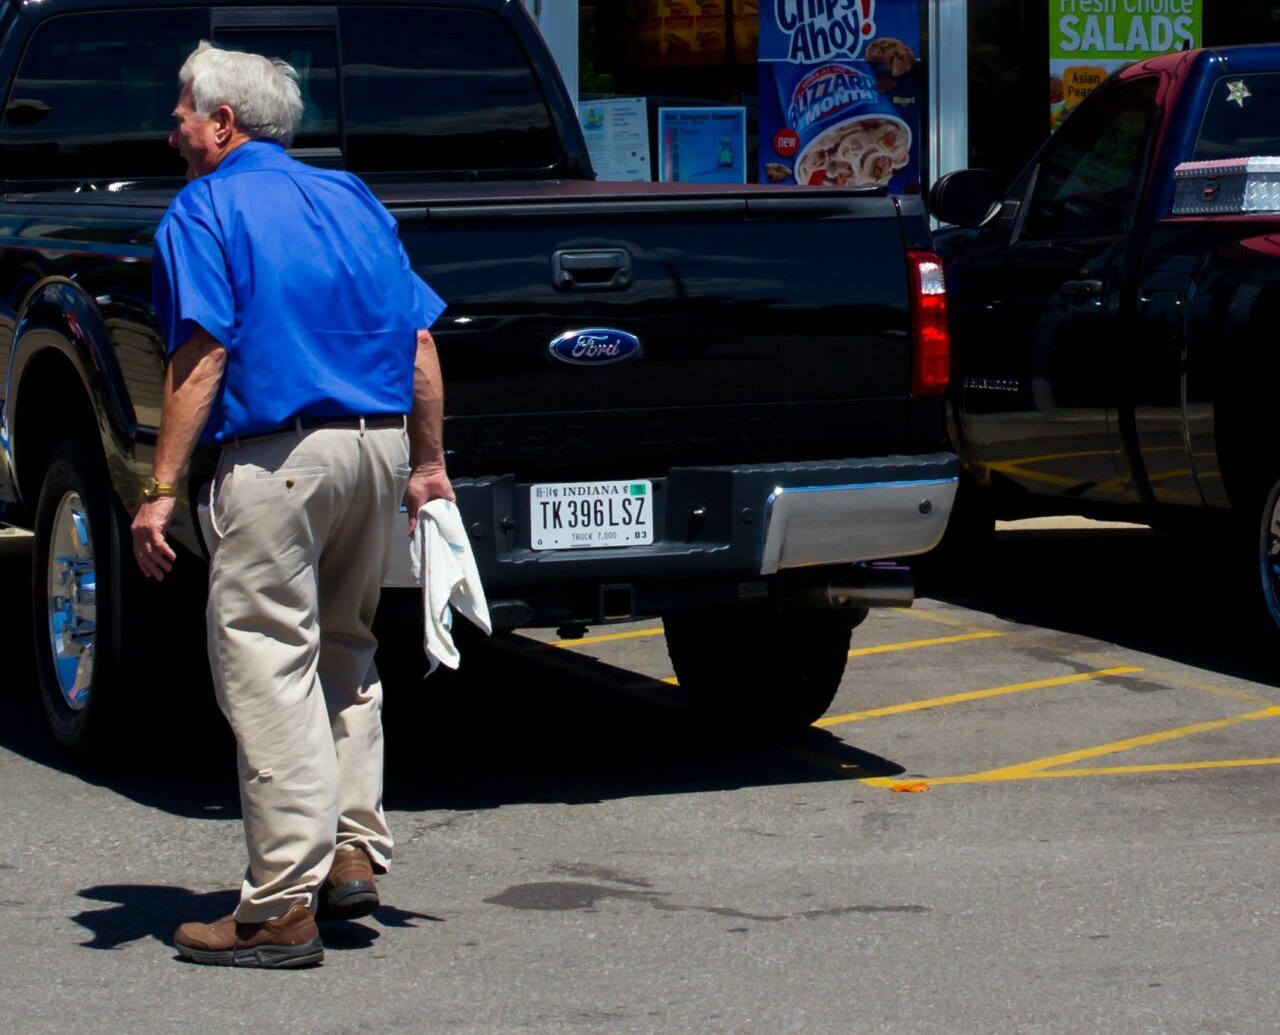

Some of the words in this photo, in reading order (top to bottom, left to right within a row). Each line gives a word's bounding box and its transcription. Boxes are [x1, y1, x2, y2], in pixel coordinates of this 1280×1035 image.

[1058, 14, 1195, 52] SALADS
[1071, 71, 1101, 85] Asian
[803, 87, 873, 127] MONTH
[778, 133, 796, 148] new
[572, 335, 620, 358] Ford
[563, 485, 619, 497] INDIANA
[540, 497, 646, 530] TK396LSZ
[572, 533, 593, 541] TRUCK
[634, 531, 647, 539] 03
